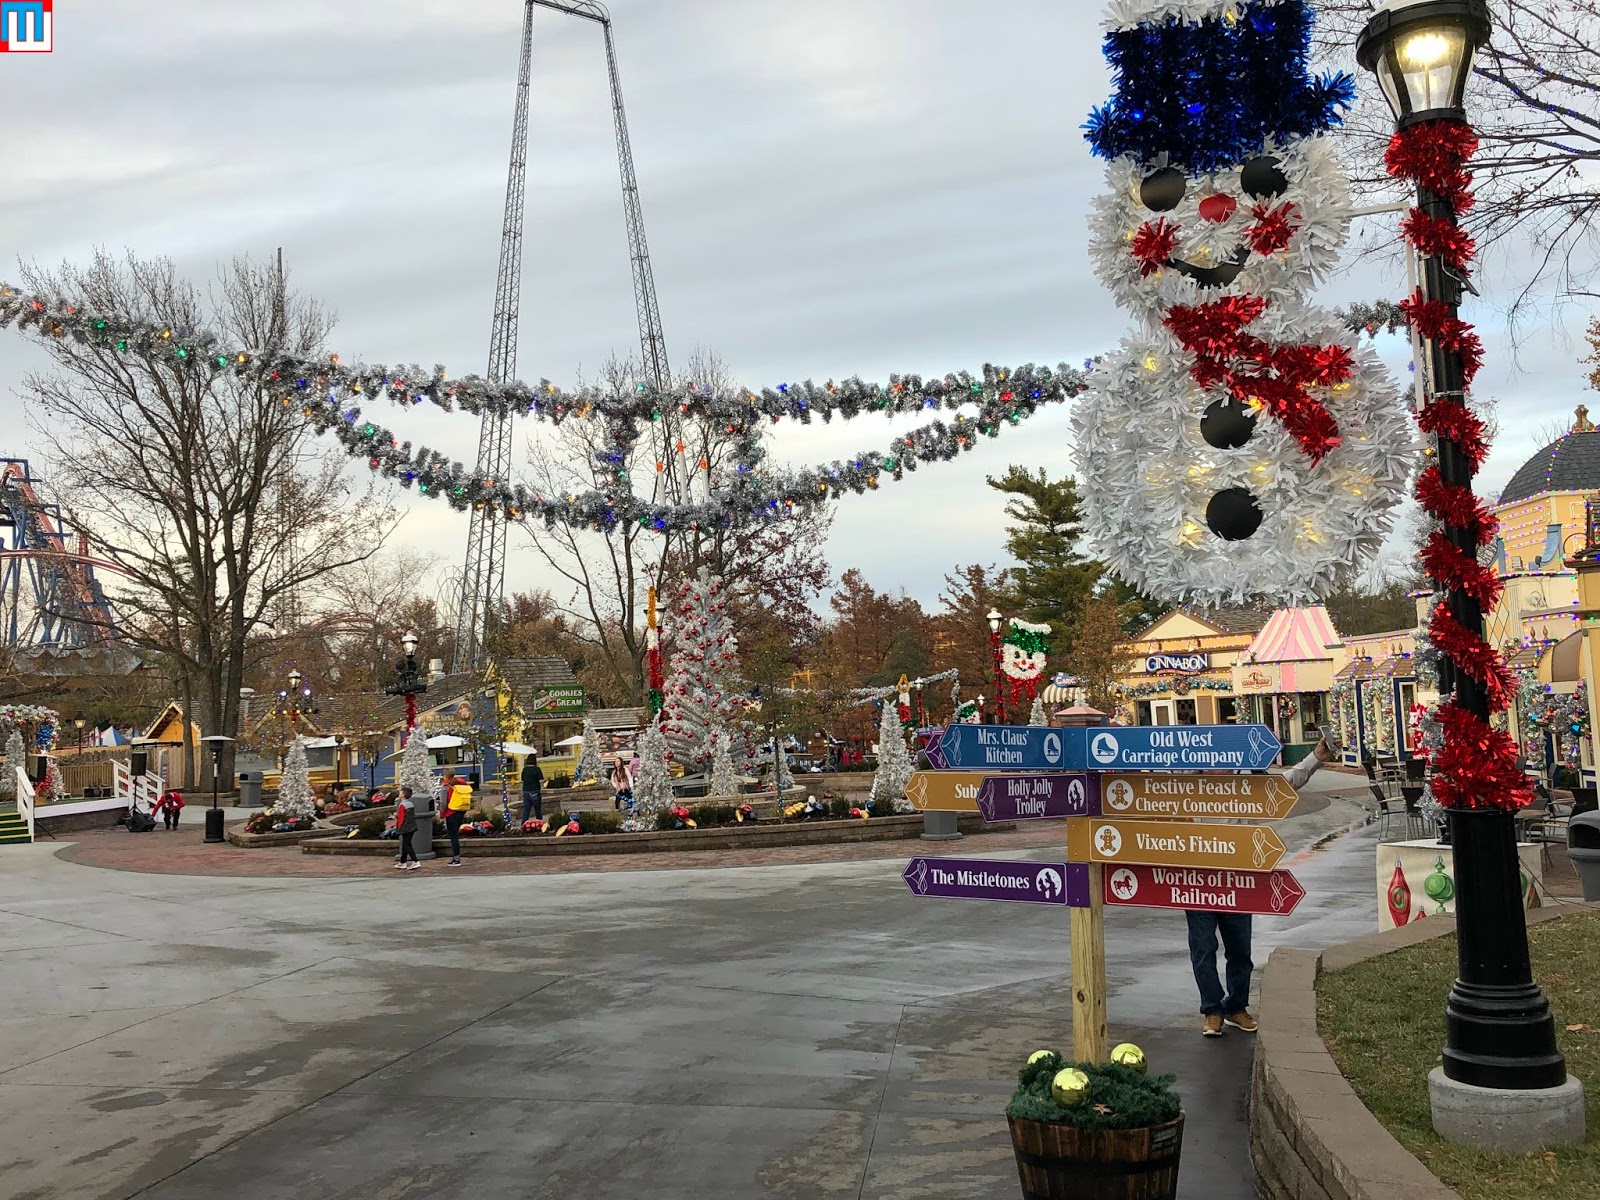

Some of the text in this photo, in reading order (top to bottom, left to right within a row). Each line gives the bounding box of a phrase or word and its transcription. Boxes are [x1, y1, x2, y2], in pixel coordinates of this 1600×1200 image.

[1146, 653, 1208, 671] CINNABON
[549, 690, 583, 698] COOKIES
[556, 698, 583, 707] CREAM
[977, 728, 1030, 746] Mrs. Claus'
[1149, 730, 1213, 747] Old West
[985, 747, 1023, 764] Kitchen
[1122, 748, 1244, 767] Carriage Company
[955, 783, 980, 799] Sub
[1007, 778, 1053, 799] Holly Jolly
[1144, 778, 1252, 796] Festive Feast &
[1015, 798, 1046, 817] Trolley
[1135, 797, 1263, 815] Cheery Concoctions
[1136, 833, 1236, 855] Vixen's Fixins
[931, 868, 1030, 889] The Mistletones
[1152, 868, 1256, 889] Worlds of Fun
[1171, 887, 1237, 907] Railroad
